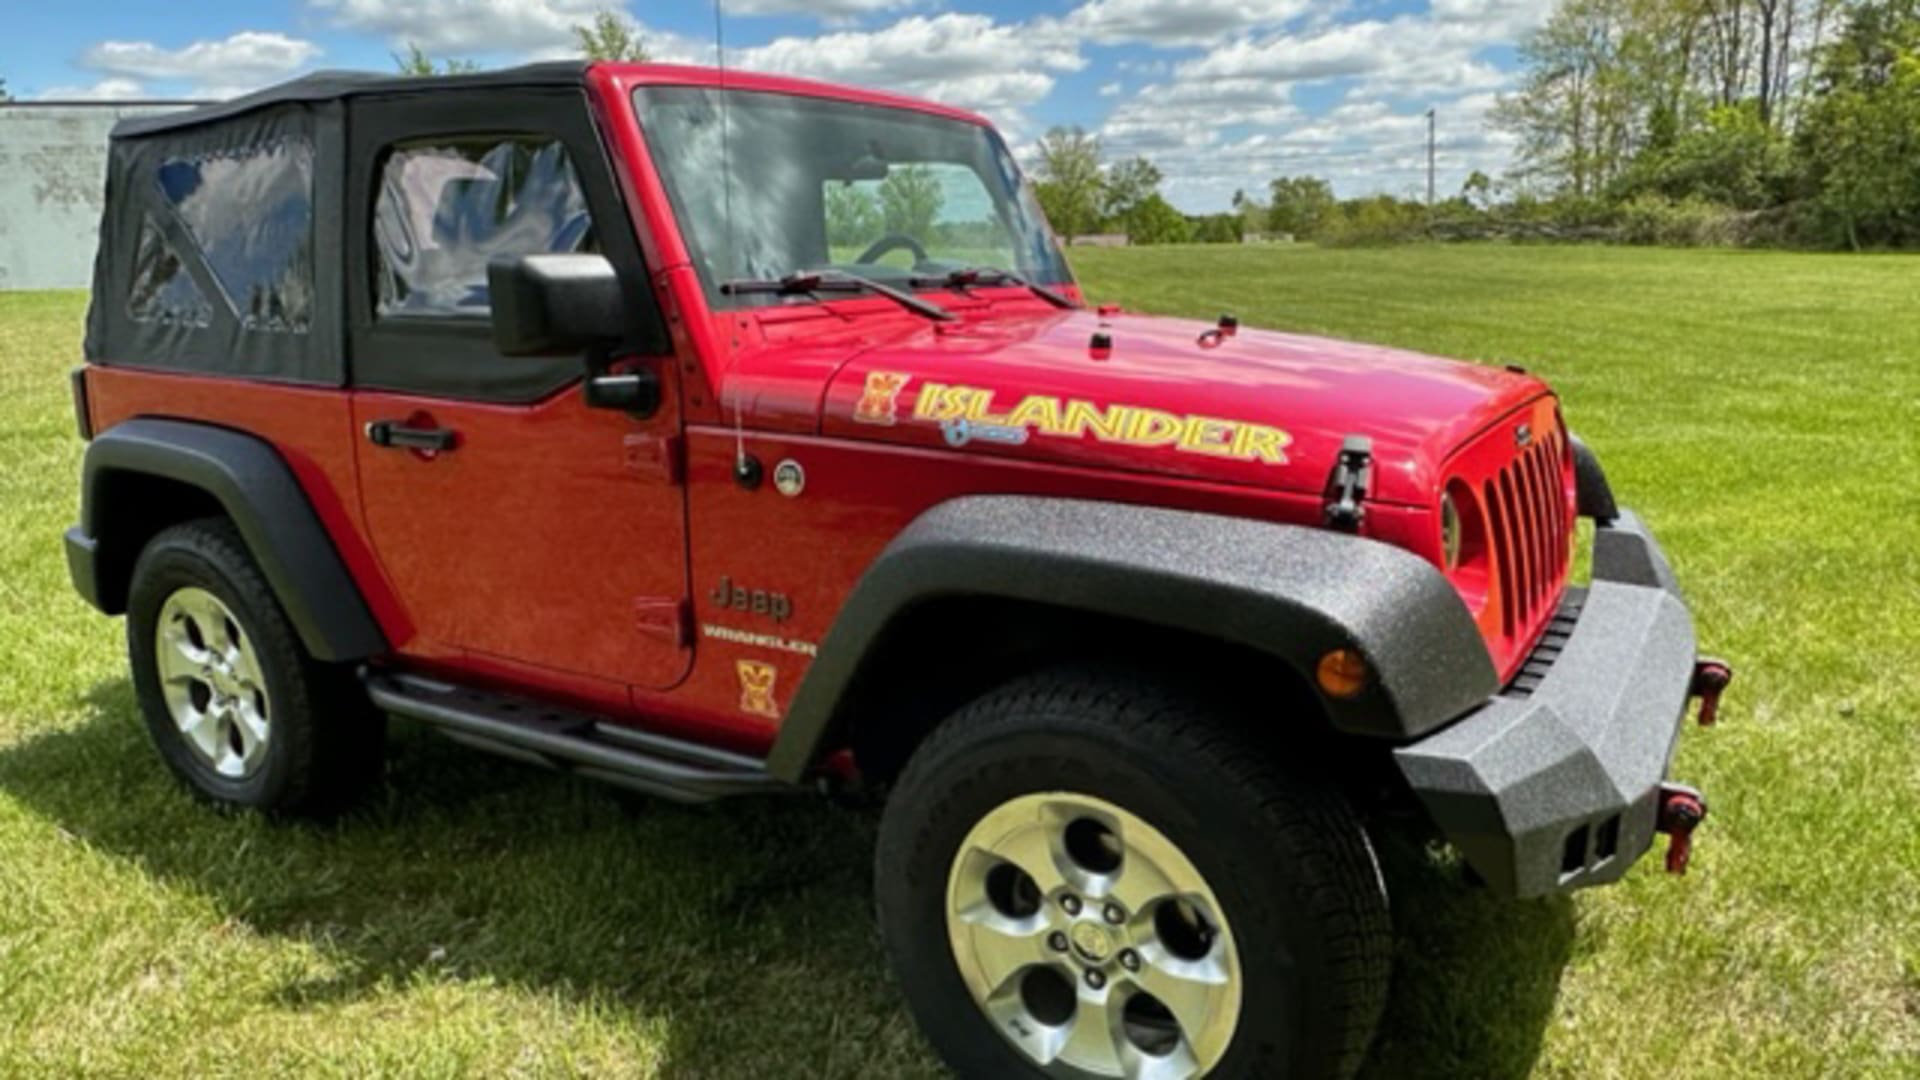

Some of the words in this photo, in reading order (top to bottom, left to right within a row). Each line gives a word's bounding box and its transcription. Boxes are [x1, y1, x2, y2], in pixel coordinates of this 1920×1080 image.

[913, 383, 1293, 464] ISLANDER
[709, 576, 792, 622] Jeep
[703, 624, 817, 657] WRANGLER
